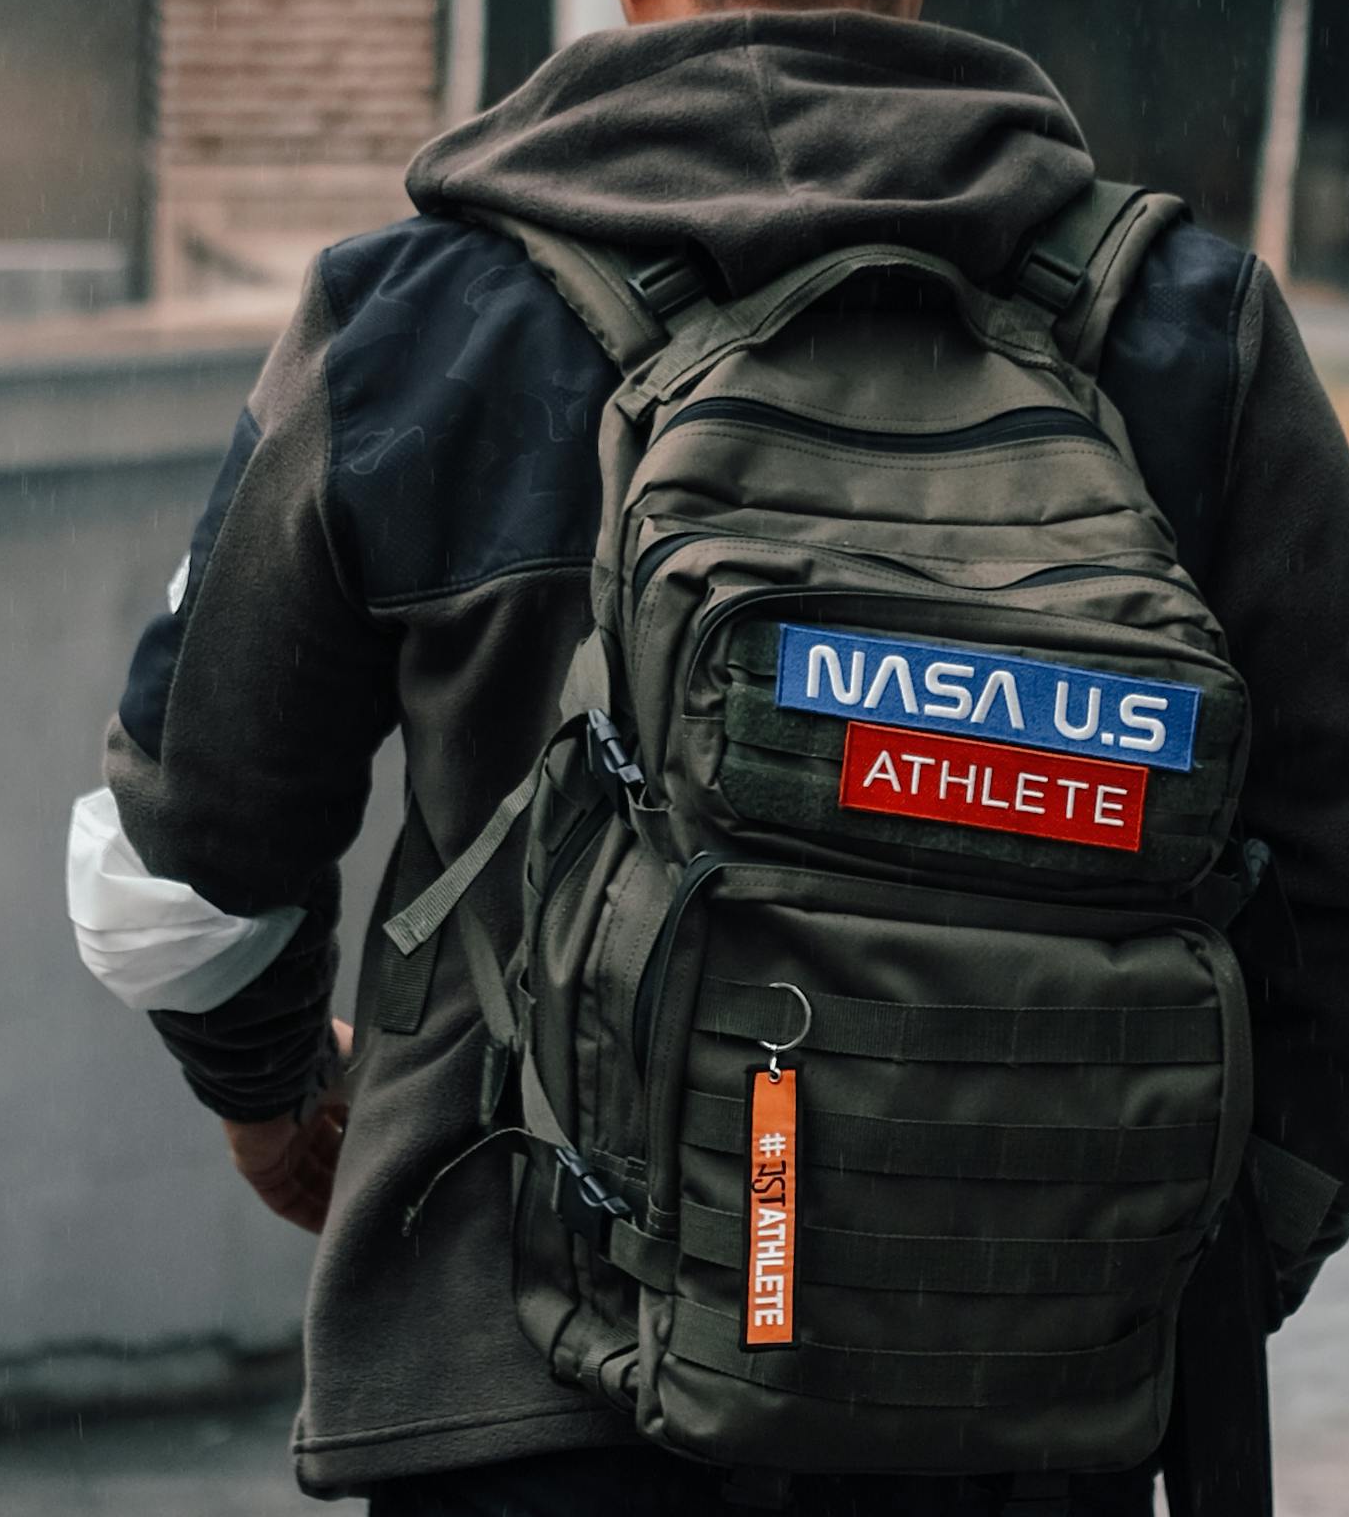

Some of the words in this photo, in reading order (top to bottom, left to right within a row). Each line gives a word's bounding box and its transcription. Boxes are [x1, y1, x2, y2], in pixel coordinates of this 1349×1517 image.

[806, 644, 1026, 730] NASA
[1053, 679, 1169, 753] U.S
[862, 749, 1129, 828] ATHLETE
